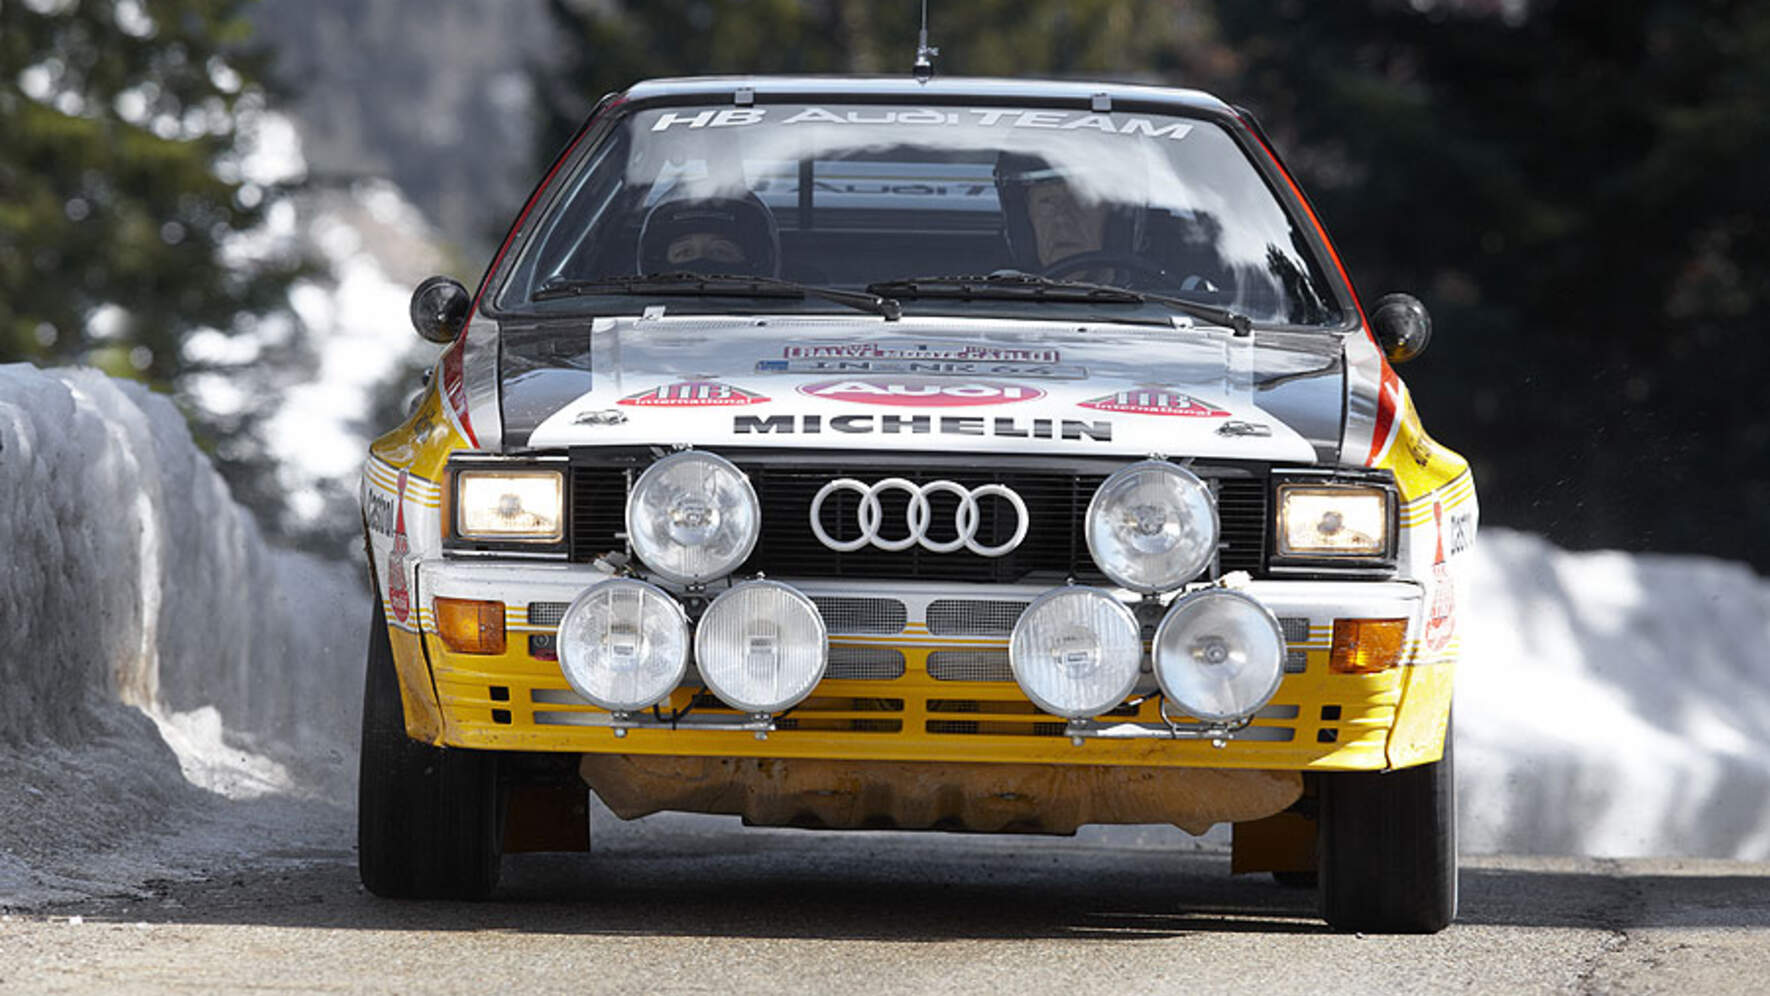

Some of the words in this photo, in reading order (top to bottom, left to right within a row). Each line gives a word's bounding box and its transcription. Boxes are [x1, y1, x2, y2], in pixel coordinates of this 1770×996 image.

[651, 108, 767, 131] HB
[969, 109, 1195, 140] TEAM
[733, 414, 1112, 442] MICHELIN
